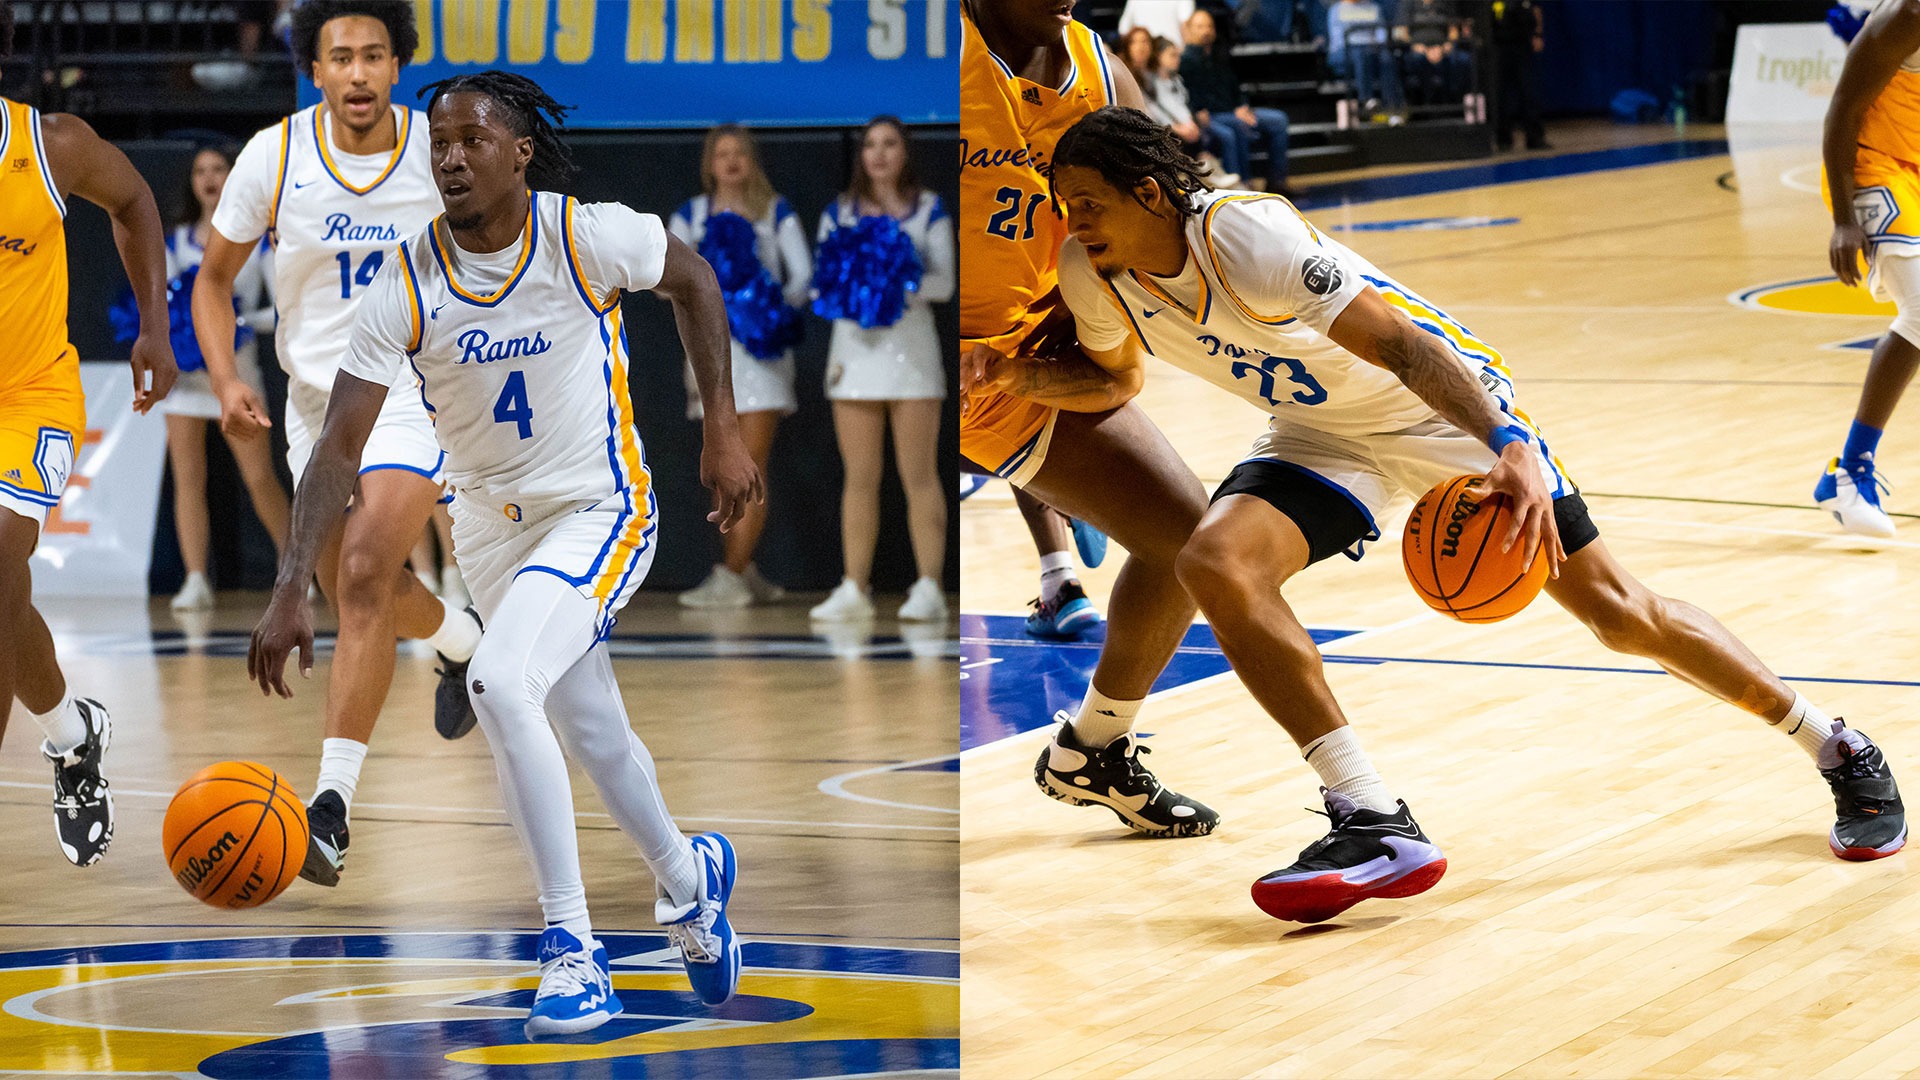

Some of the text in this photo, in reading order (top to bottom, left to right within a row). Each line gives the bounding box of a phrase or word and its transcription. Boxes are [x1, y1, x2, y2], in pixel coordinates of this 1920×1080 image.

[320, 212, 400, 241] Rams
[985, 186, 1047, 241] 21
[335, 249, 384, 300] 14
[454, 329, 552, 365] Rams
[493, 370, 534, 441] 4
[1231, 355, 1328, 407] 23
